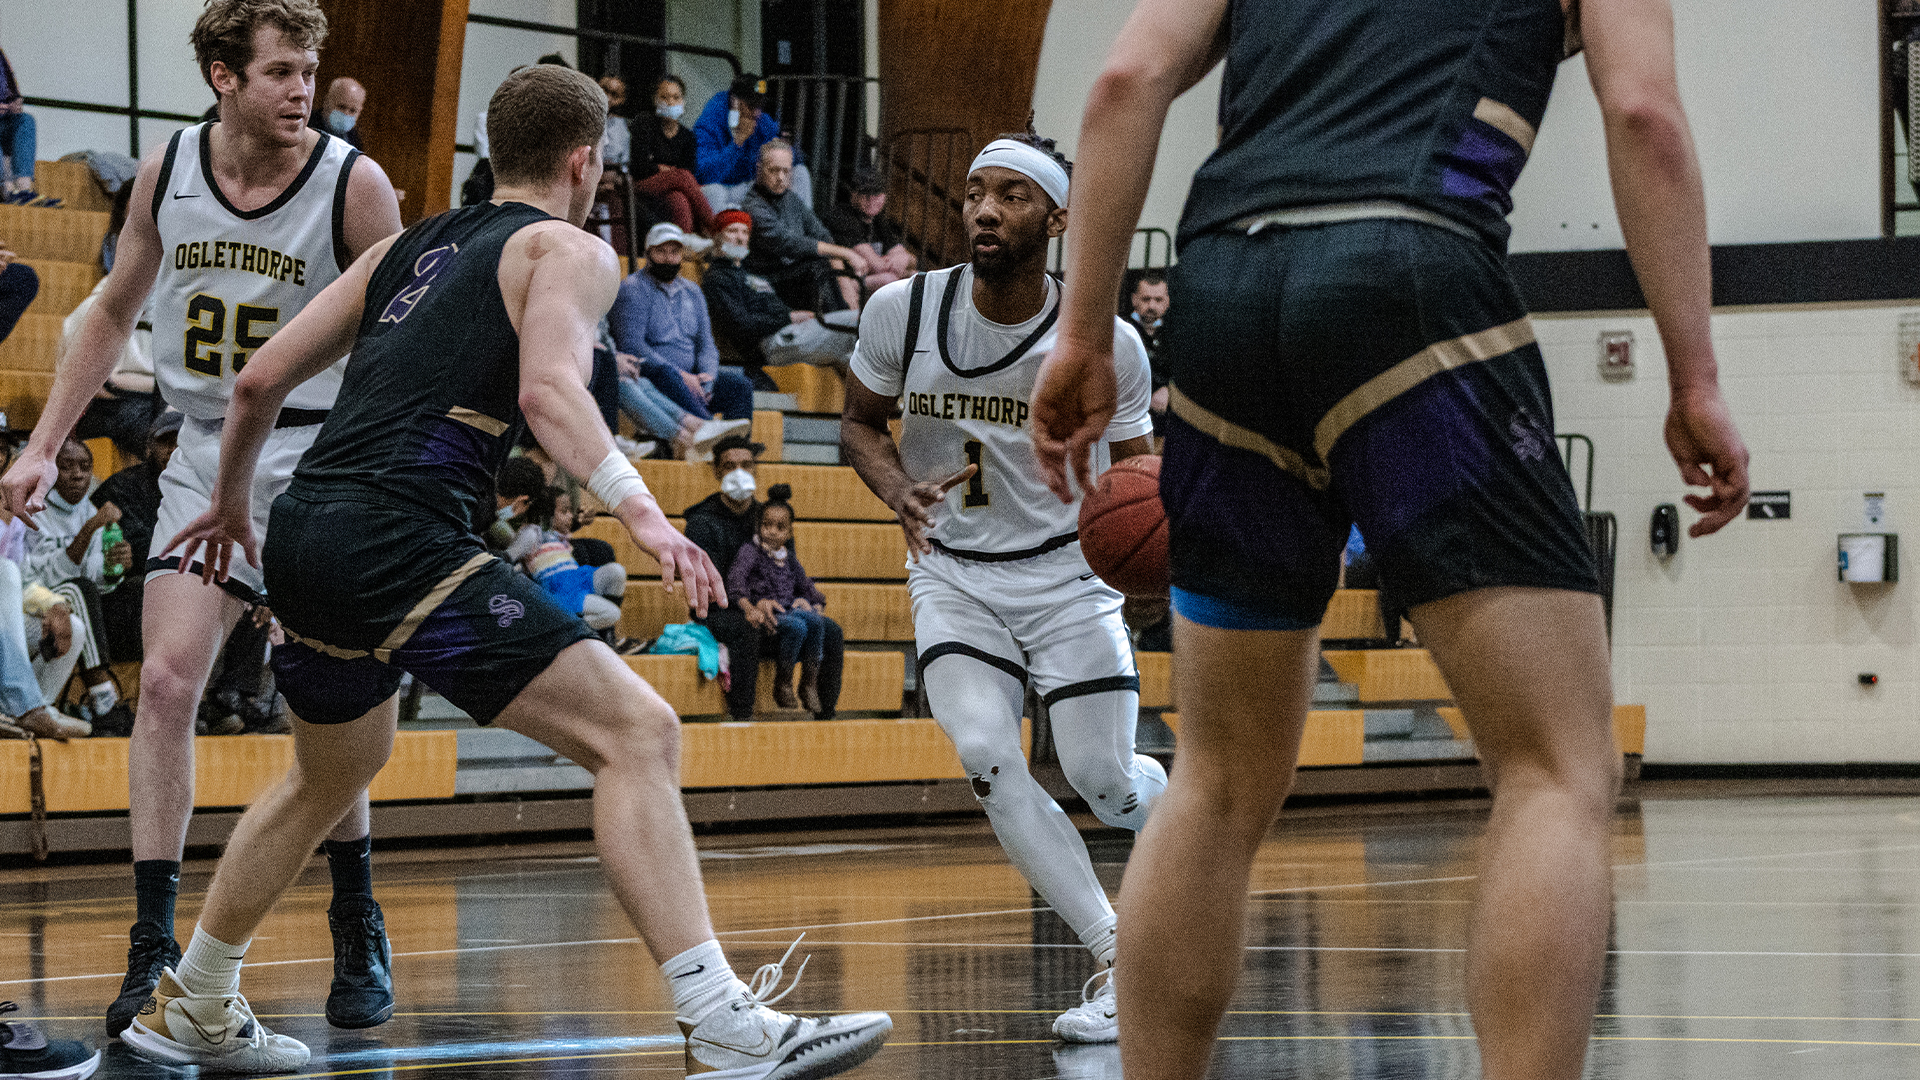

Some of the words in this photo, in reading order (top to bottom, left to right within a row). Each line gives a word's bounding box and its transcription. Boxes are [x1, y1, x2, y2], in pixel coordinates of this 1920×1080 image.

[175, 241, 306, 287] OGLETHORPE
[184, 292, 279, 379] 25
[908, 391, 1029, 428] OGLETHORP
[963, 440, 989, 509] 1
